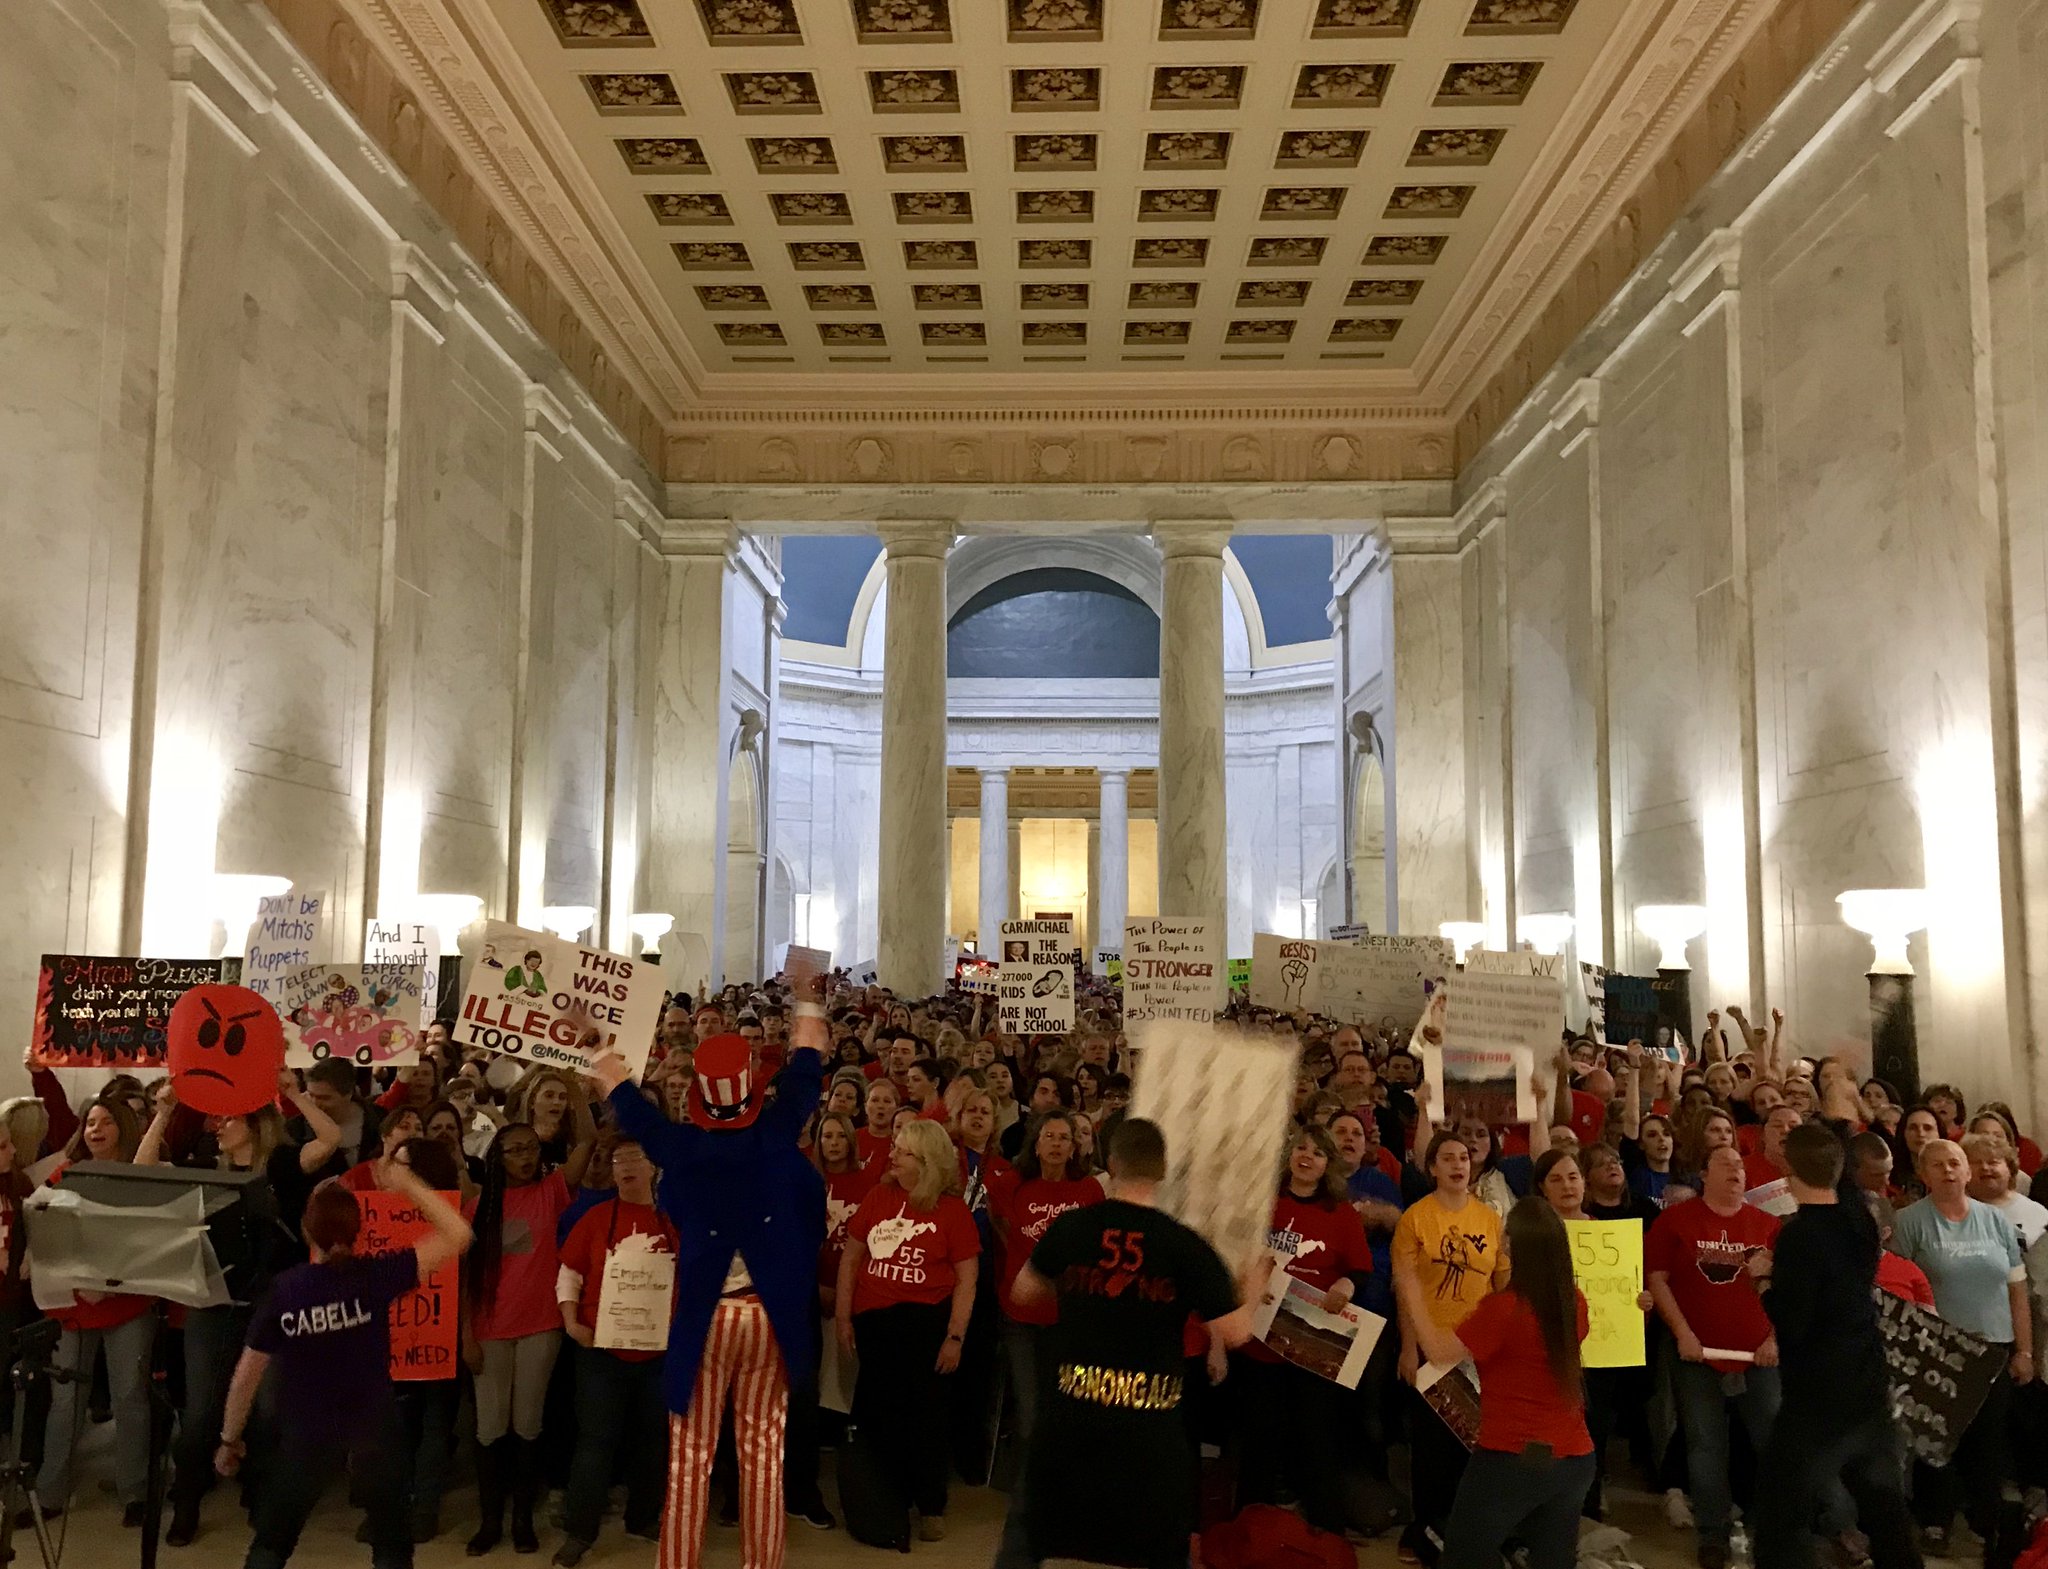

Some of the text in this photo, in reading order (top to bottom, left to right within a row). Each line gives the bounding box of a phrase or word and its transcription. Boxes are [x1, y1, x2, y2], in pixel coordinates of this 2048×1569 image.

[300, 894, 319, 915] be
[258, 917, 314, 941] Mitch's
[369, 922, 425, 944] And I
[1001, 922, 1070, 934] CARMICHAEL
[1152, 921, 1187, 935] Power
[1039, 939, 1057, 952] THE
[1158, 939, 1190, 954] People
[249, 947, 309, 972] Puppets
[374, 948, 428, 966] thought
[579, 950, 634, 979] THIS
[1032, 952, 1074, 966] REASON
[1528, 956, 1556, 976] WV
[286, 964, 327, 990] ELECT
[361, 964, 418, 976] EXPECT
[1126, 959, 1213, 979] STRONGER
[72, 984, 188, 1004] didn't your mom
[287, 981, 330, 1010] CLOWN
[362, 976, 371, 986] a
[380, 975, 420, 997] CIRCUS
[573, 973, 629, 1002] WAS
[1001, 986, 1026, 999] KIDS
[61, 1002, 95, 1018] teach
[98, 1008, 121, 1022] you
[124, 1002, 141, 1018] not
[146, 1002, 159, 1017] to
[552, 992, 625, 1025] ONCE
[1000, 1007, 1047, 1019] ARE NOT
[1006, 1020, 1067, 1033] IN SCHOOL
[468, 1023, 523, 1054] TOO
[531, 1043, 597, 1069] @Morris
[365, 1229, 391, 1249] for
[1577, 1231, 1620, 1267] 55
[1696, 1240, 1745, 1253] UNITED
[898, 1246, 926, 1267] 55
[1098, 1228, 1146, 1272] 55
[867, 1258, 927, 1284] UNITED
[1573, 1264, 1639, 1306] trong!
[280, 1298, 372, 1338] CABELL
